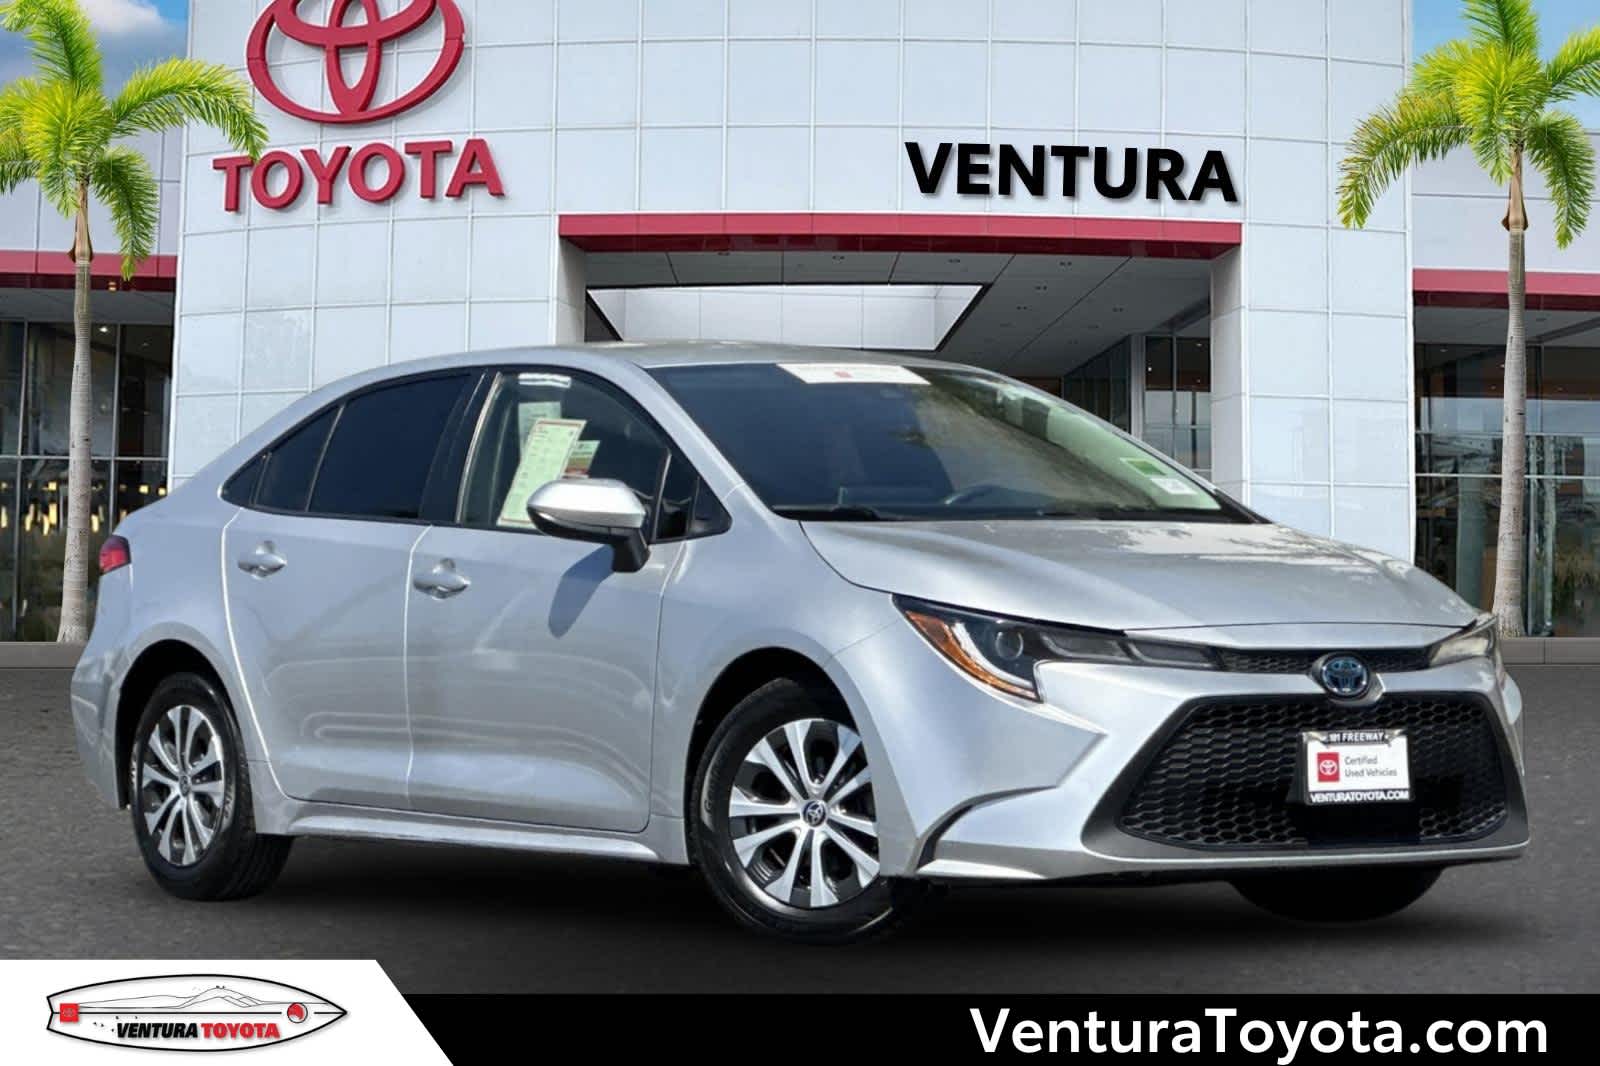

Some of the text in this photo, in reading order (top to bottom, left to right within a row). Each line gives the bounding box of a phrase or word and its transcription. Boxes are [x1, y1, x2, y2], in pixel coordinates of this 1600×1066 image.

[212, 139, 504, 212] TOYOTA
[904, 142, 1239, 202] VENTURA
[1342, 732, 1384, 741] FREEWAY
[1344, 756, 1378, 765] Certified
[1344, 767, 1397, 777] Used Vehicles
[1310, 790, 1409, 803] VENTURATOYOTA.COM
